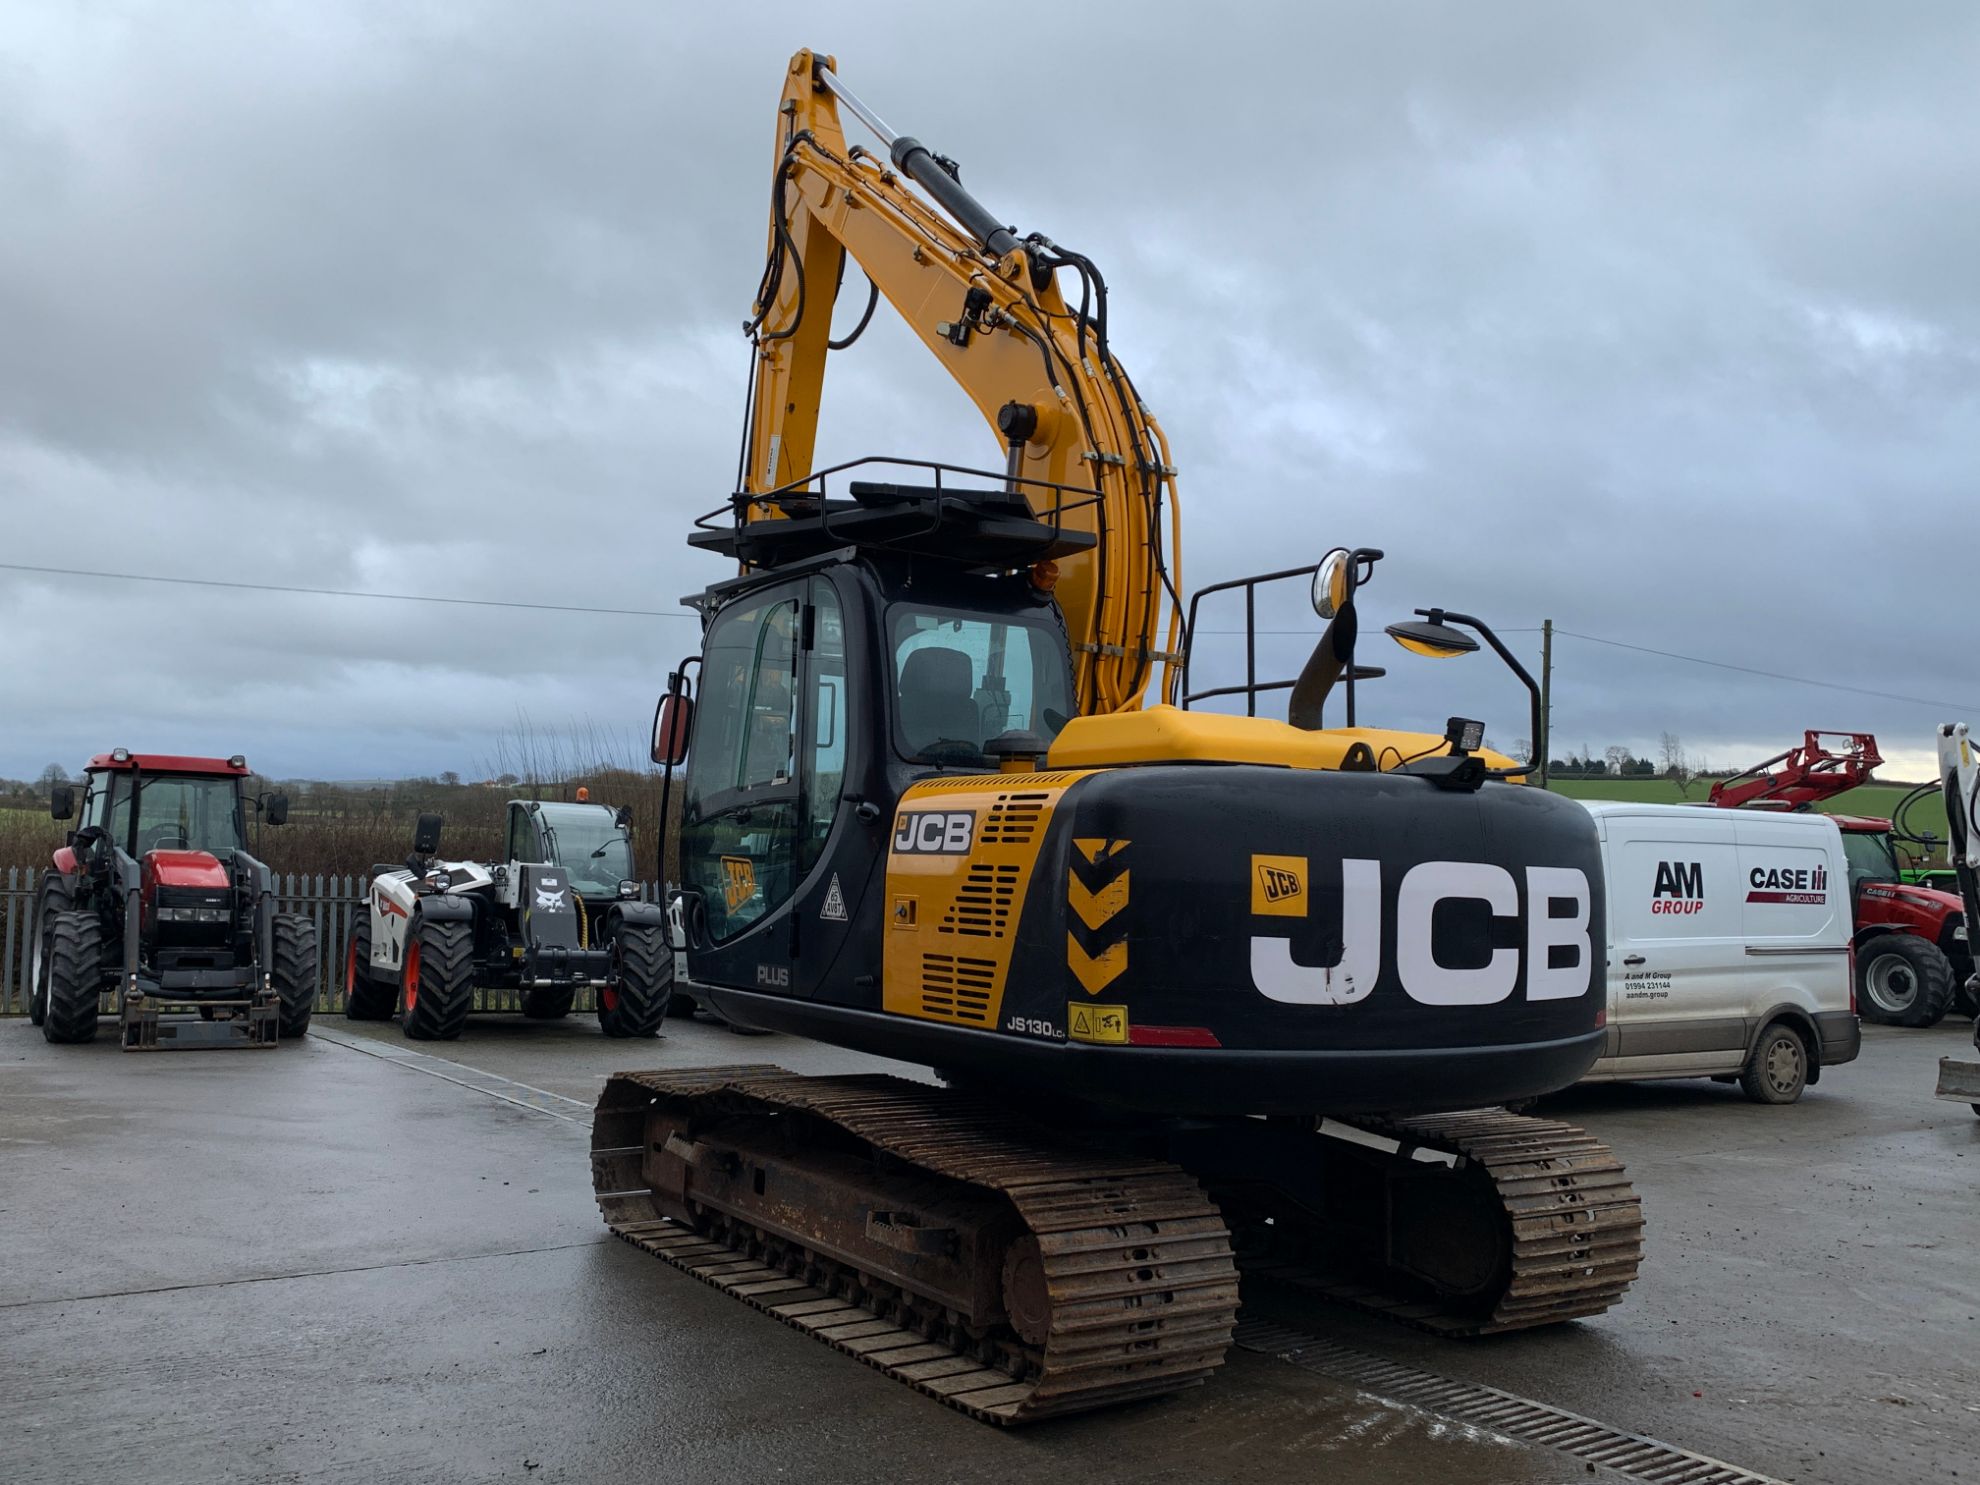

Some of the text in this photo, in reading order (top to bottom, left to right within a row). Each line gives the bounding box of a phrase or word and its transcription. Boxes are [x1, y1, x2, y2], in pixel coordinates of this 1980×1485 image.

[895, 814, 972, 851] JCB
[726, 861, 753, 906] JCB
[1266, 869, 1299, 898] JCB
[1653, 861, 1703, 899] AM
[1750, 867, 1807, 890] CASE
[1652, 900, 1703, 915] GROUP
[1785, 894, 1825, 904] AGRICULTURE
[1250, 858, 1593, 1006] JCB
[757, 965, 789, 986] PLUS
[1625, 982, 1671, 990] 01994 231144
[1631, 972, 1643, 980] and
[1645, 972, 1651, 980] M
[1652, 972, 1671, 981] Group
[1626, 991, 1669, 1000] aandm.group
